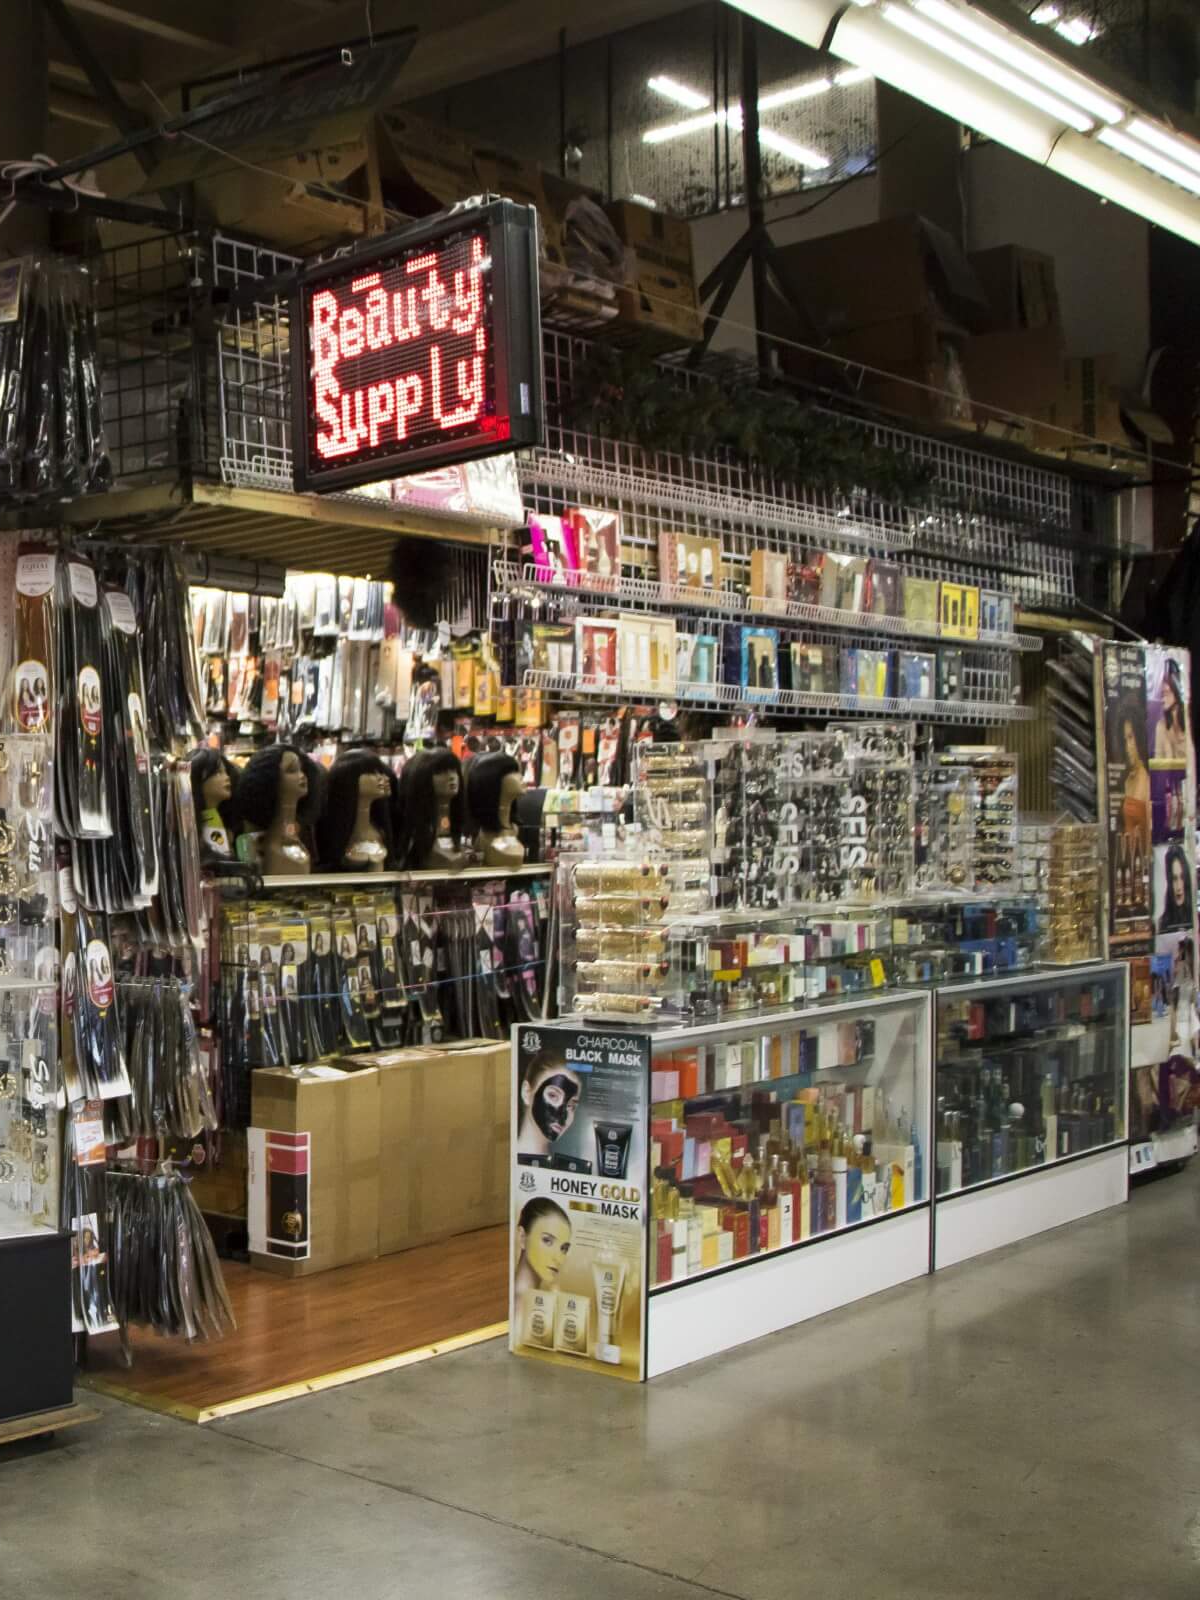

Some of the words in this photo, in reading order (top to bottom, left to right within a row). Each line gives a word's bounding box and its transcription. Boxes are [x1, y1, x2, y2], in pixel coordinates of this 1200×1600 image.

[313, 253, 482, 368] Beauty
[577, 1035, 642, 1053] CHARCOAL
[565, 1048, 603, 1063] BLACK
[608, 1052, 641, 1067] MASK
[551, 1177, 597, 1197] HONEY
[601, 1183, 641, 1203] GOLD
[601, 1203, 639, 1220] MASK
